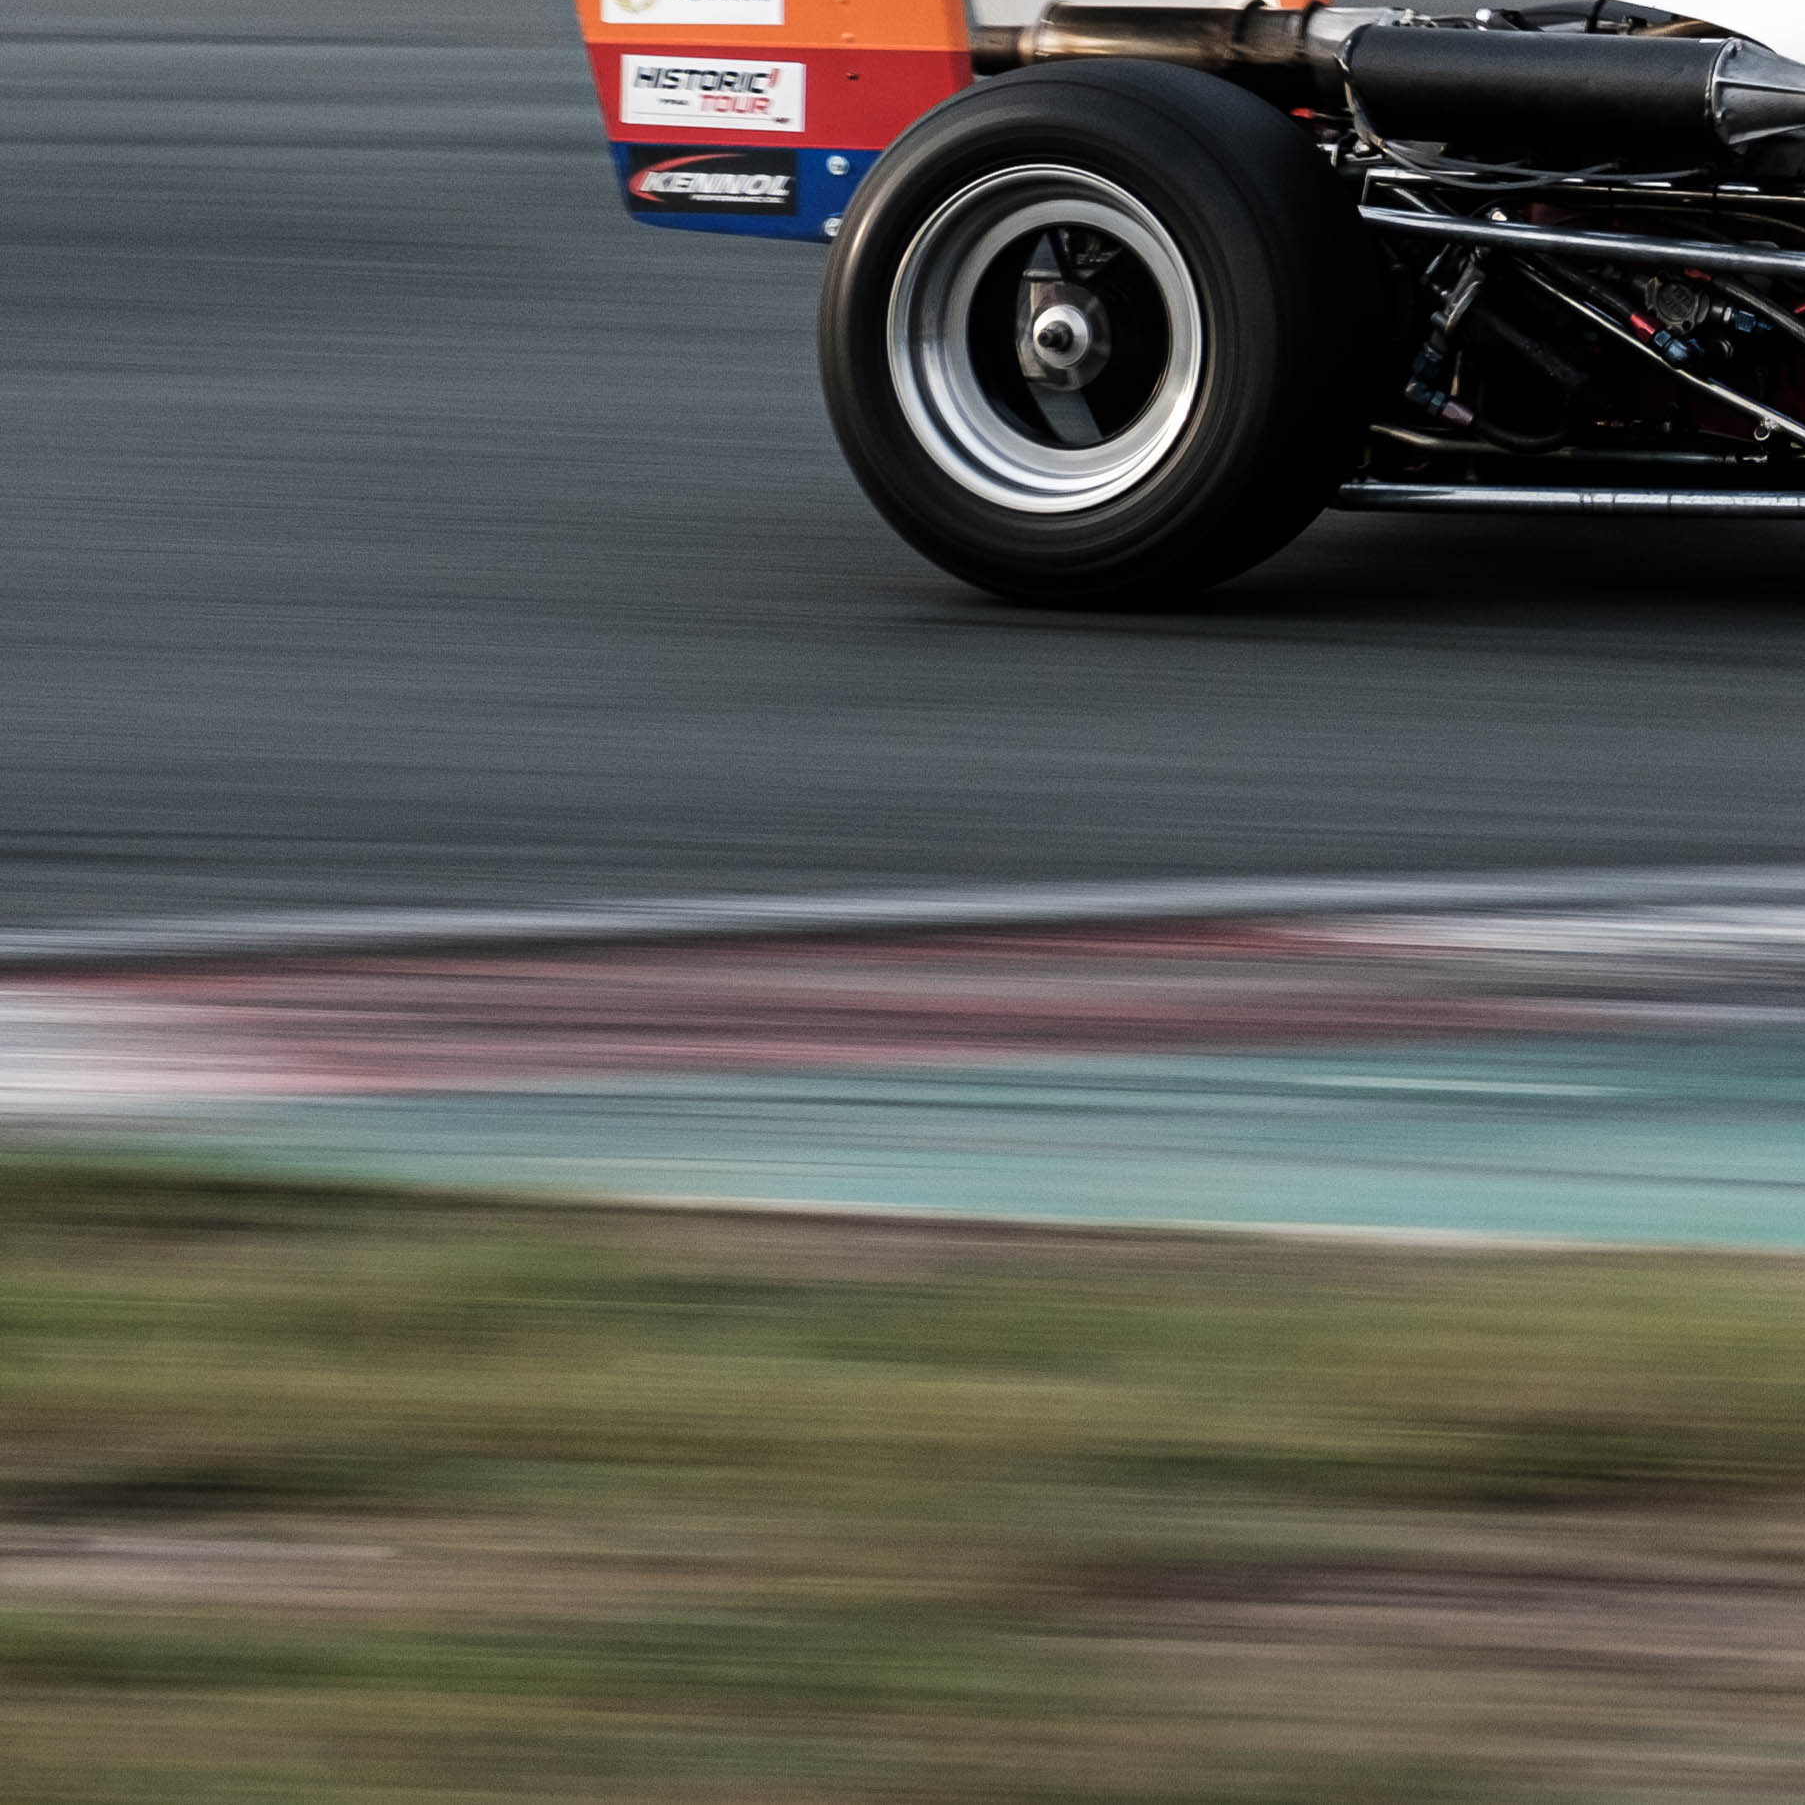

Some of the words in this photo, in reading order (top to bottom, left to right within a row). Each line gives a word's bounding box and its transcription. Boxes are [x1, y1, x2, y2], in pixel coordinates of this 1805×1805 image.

[633, 65, 768, 94] HISTORIC
[699, 94, 770, 115] TOUR
[639, 170, 795, 197] KENNOL
